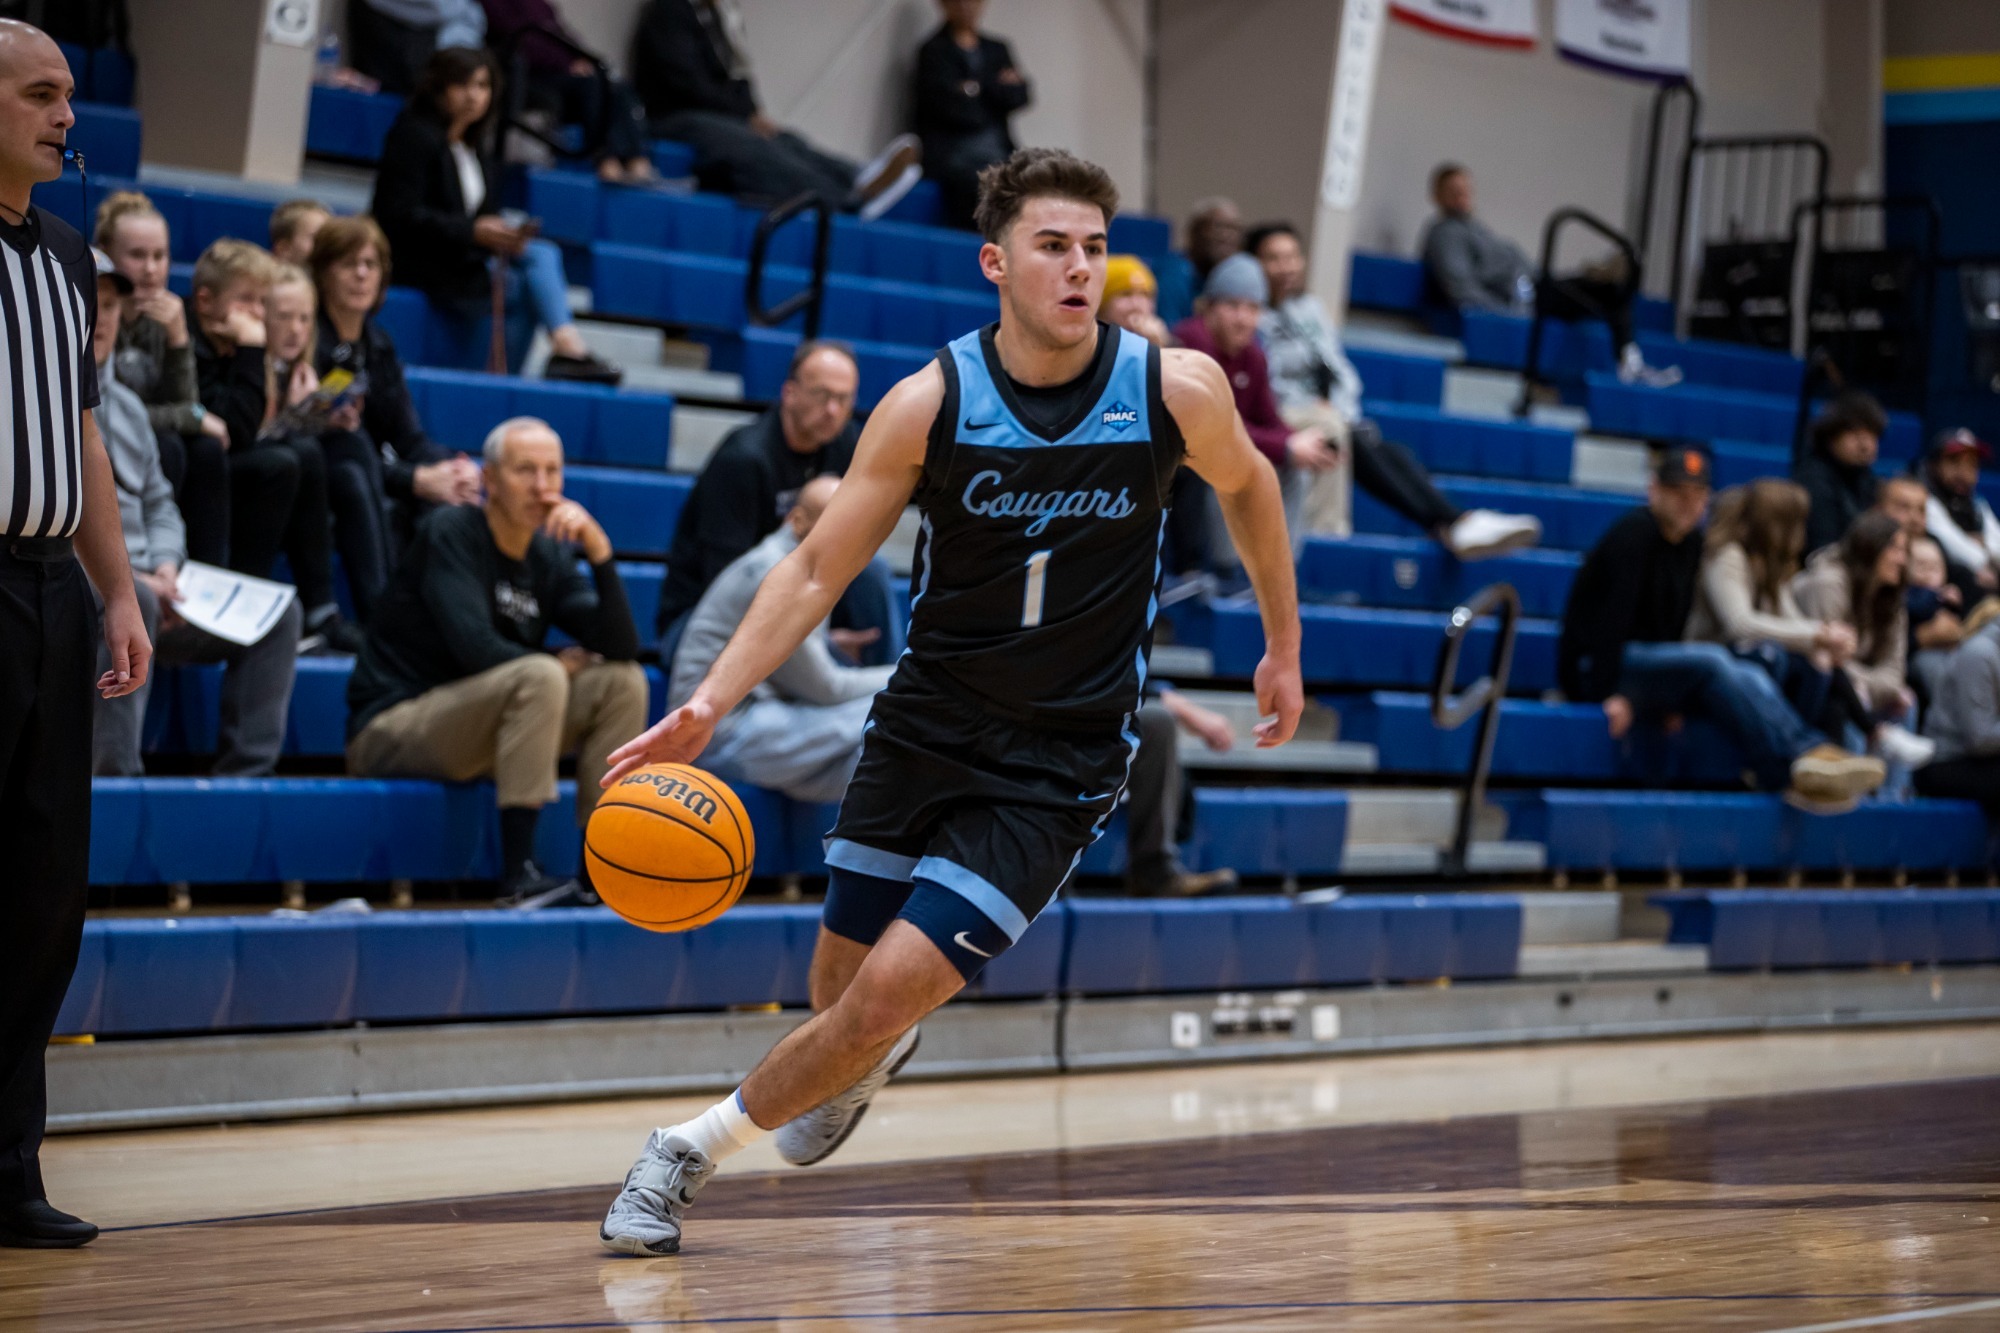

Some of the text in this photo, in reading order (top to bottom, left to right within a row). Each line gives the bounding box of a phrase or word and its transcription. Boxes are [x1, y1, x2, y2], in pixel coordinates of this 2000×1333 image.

[1103, 411, 1137, 423] RMAC
[962, 469, 1138, 537] Cougars
[1021, 550, 1052, 628] 1
[619, 772, 718, 825] Wilson
